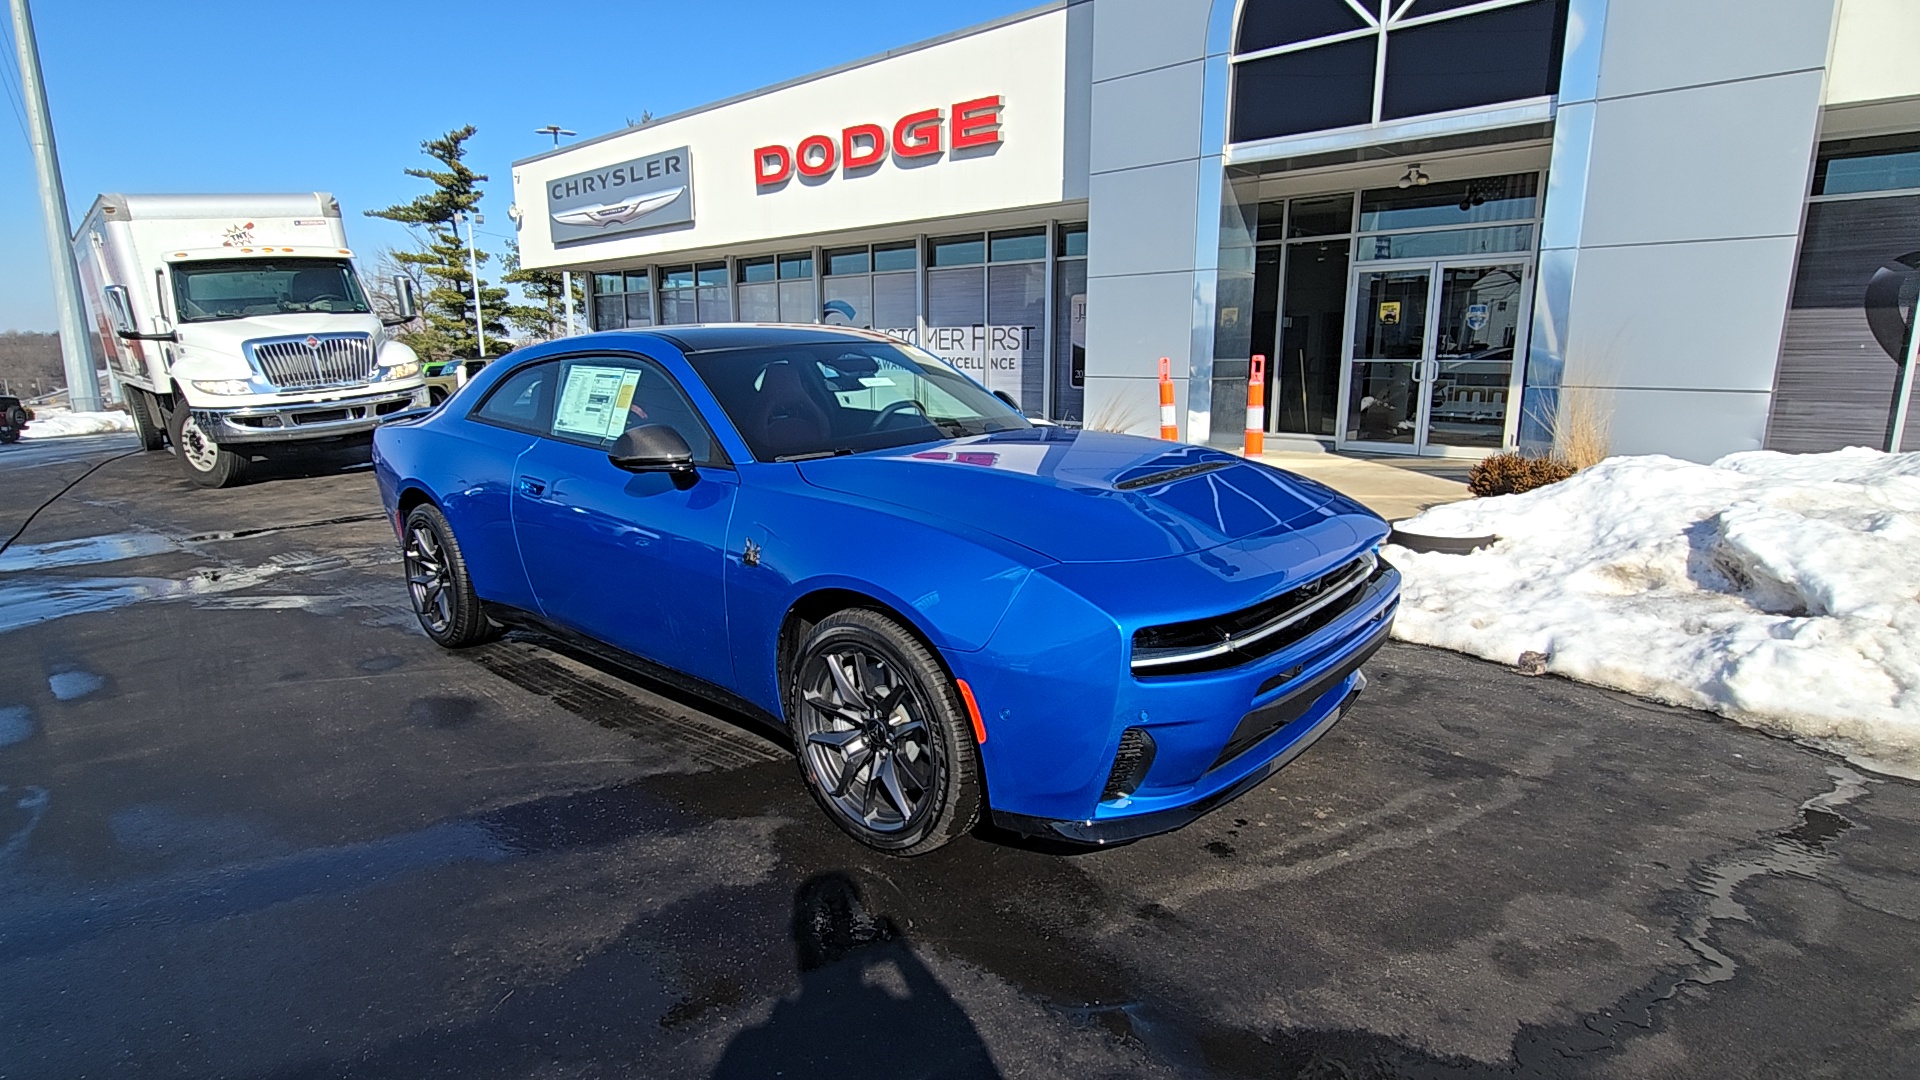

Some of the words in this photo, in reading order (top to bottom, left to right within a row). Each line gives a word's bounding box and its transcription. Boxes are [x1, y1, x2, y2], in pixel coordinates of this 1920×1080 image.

[754, 95, 1005, 185] DODGE
[551, 155, 681, 200] CHRYSLER
[230, 231, 248, 241] TNT
[941, 356, 1016, 370] XCELLNCE
